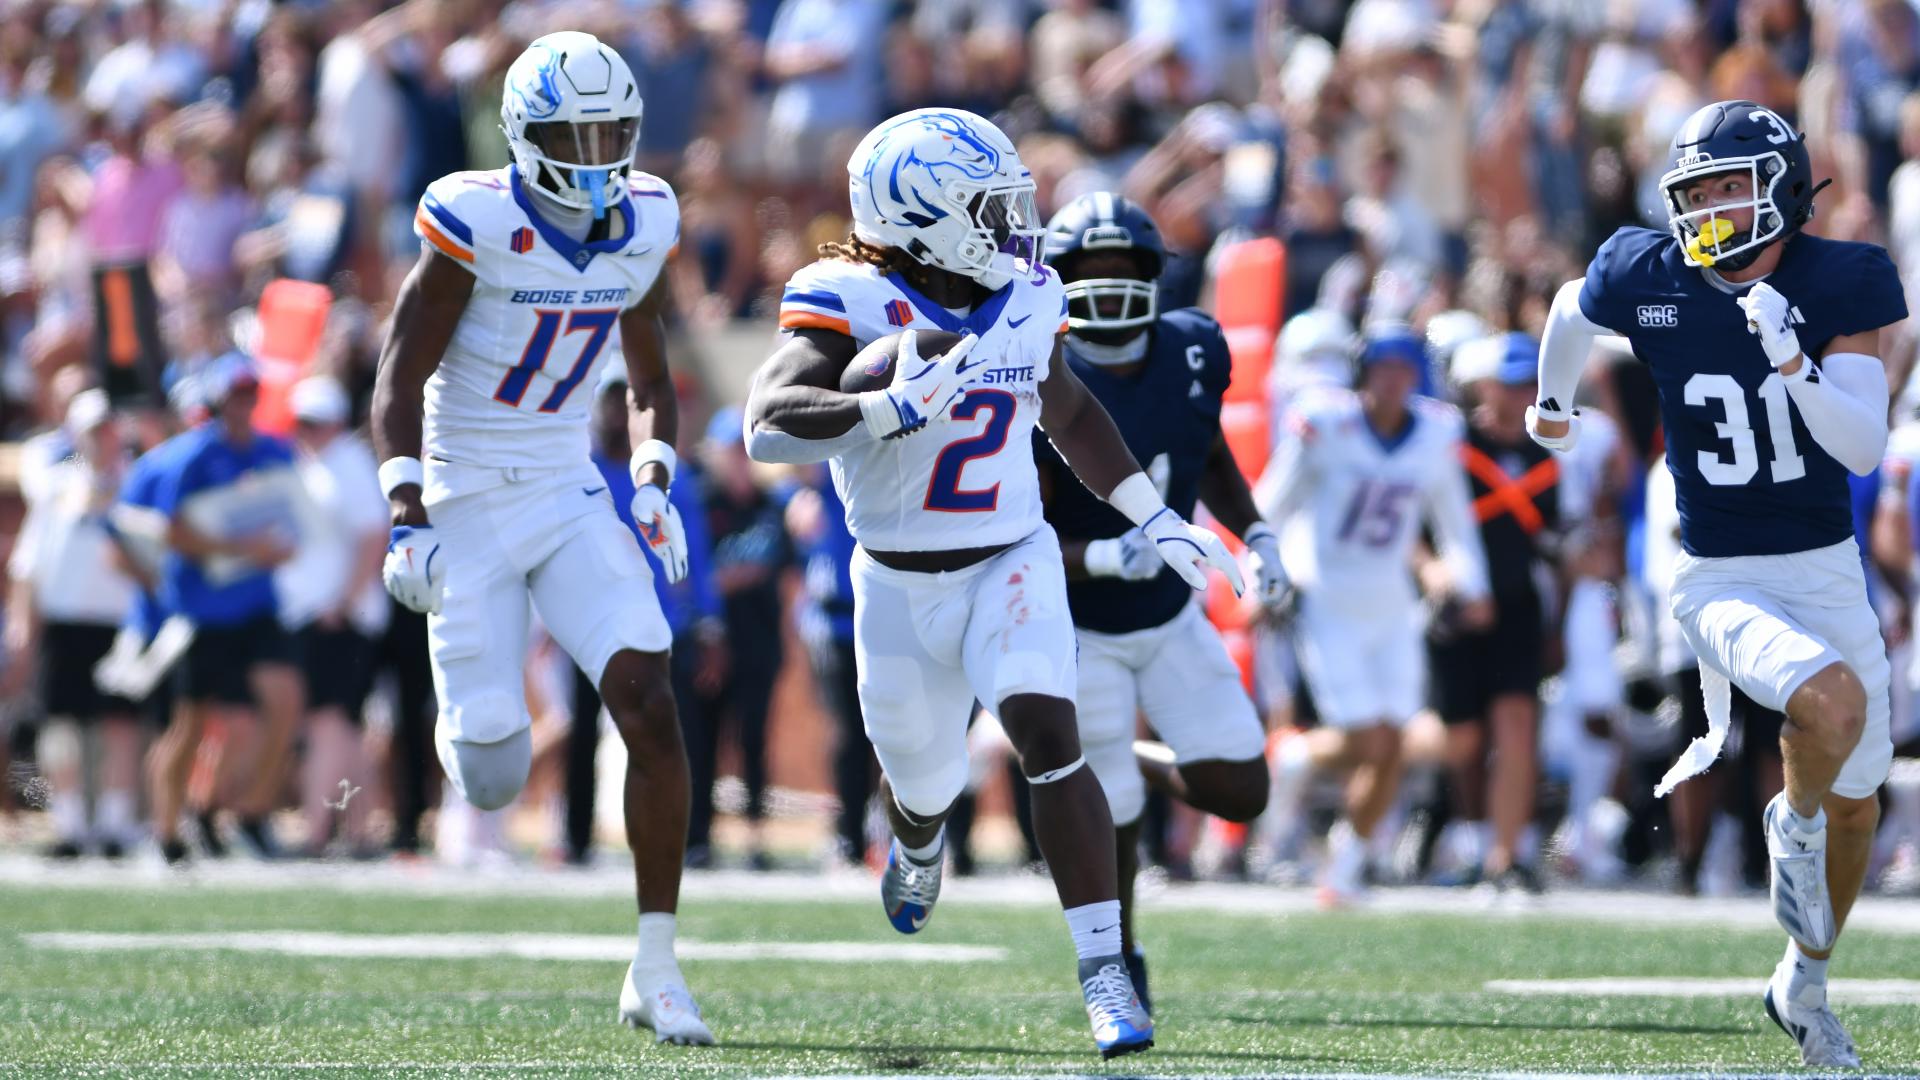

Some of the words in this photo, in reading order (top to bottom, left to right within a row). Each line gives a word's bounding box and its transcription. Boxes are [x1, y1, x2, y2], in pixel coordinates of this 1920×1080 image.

[510, 290, 577, 304] BOISE
[1636, 305, 1678, 327] SBC
[493, 306, 621, 413] 17
[983, 365, 1035, 384] STATE
[922, 388, 1017, 513] 2
[1683, 371, 1807, 487] 31
